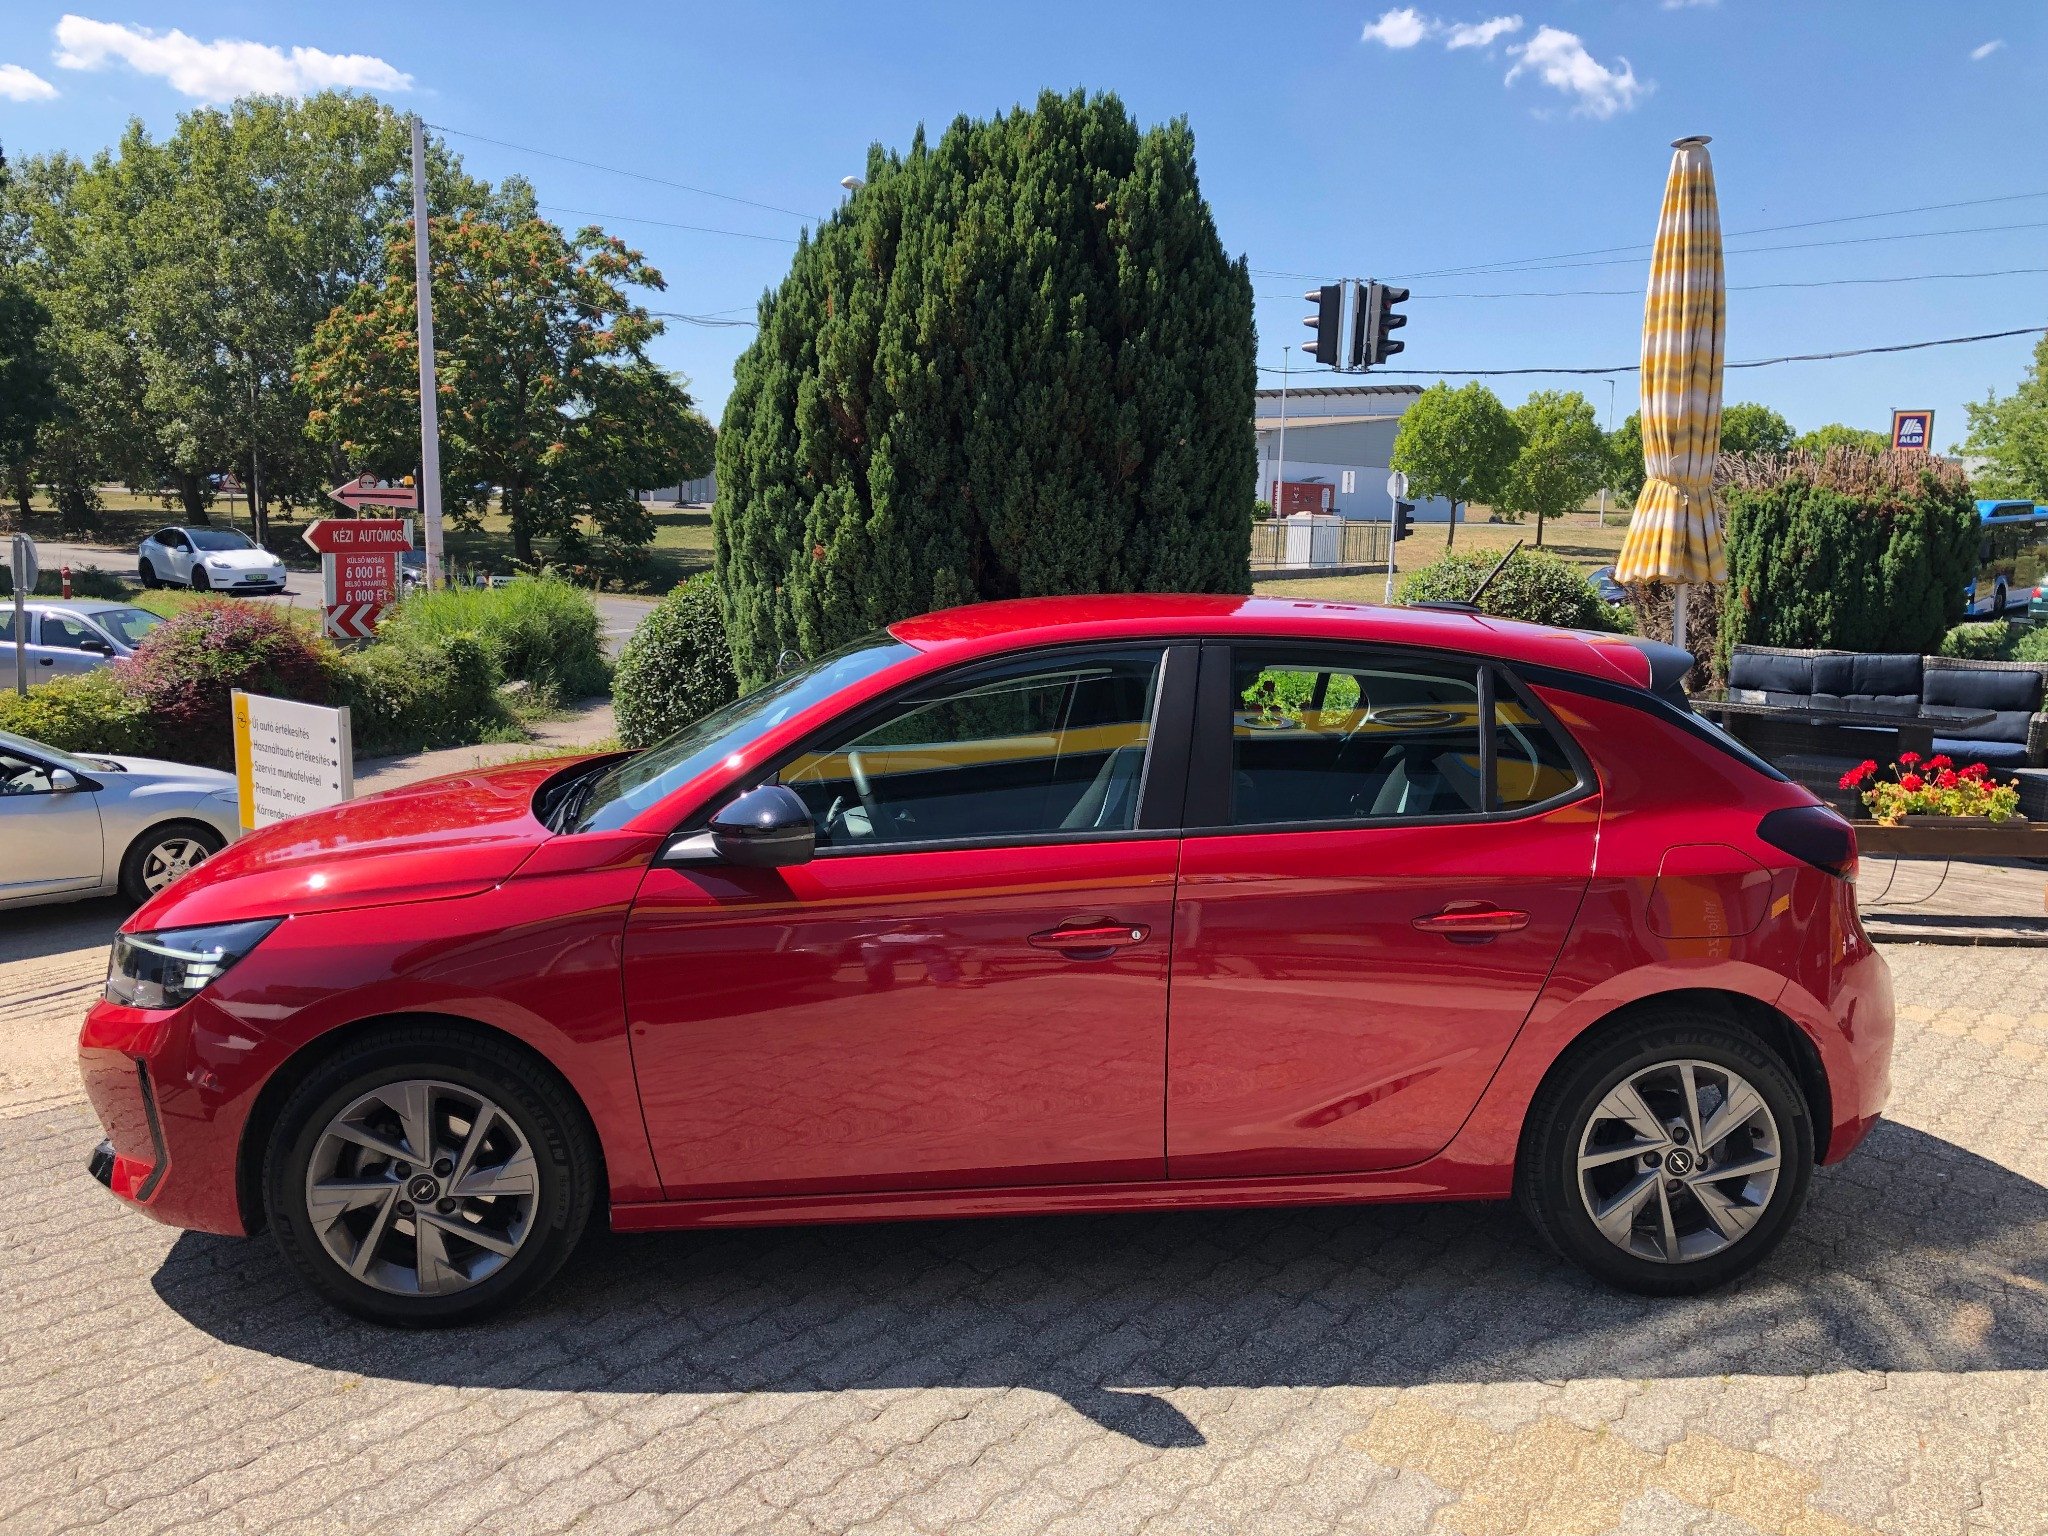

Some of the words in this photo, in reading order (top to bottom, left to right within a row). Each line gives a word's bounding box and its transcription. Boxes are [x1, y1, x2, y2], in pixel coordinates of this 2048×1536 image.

[332, 527, 354, 543] KÉZI
[358, 527, 408, 542] AUTÓMOS
[346, 567, 352, 578] 6
[355, 567, 373, 578] 000
[376, 566, 387, 578] Ft
[346, 591, 352, 602] 6
[355, 590, 374, 601] 000
[252, 716, 259, 731] Új
[260, 721, 274, 733] autó
[275, 722, 310, 740] értékesítés
[253, 740, 294, 759] Használtautó
[295, 748, 331, 767] értékesítés
[254, 761, 276, 776] Szerviz
[278, 768, 322, 787] munkafelvétel
[255, 782, 281, 798] Premium
[282, 788, 306, 804] Service
